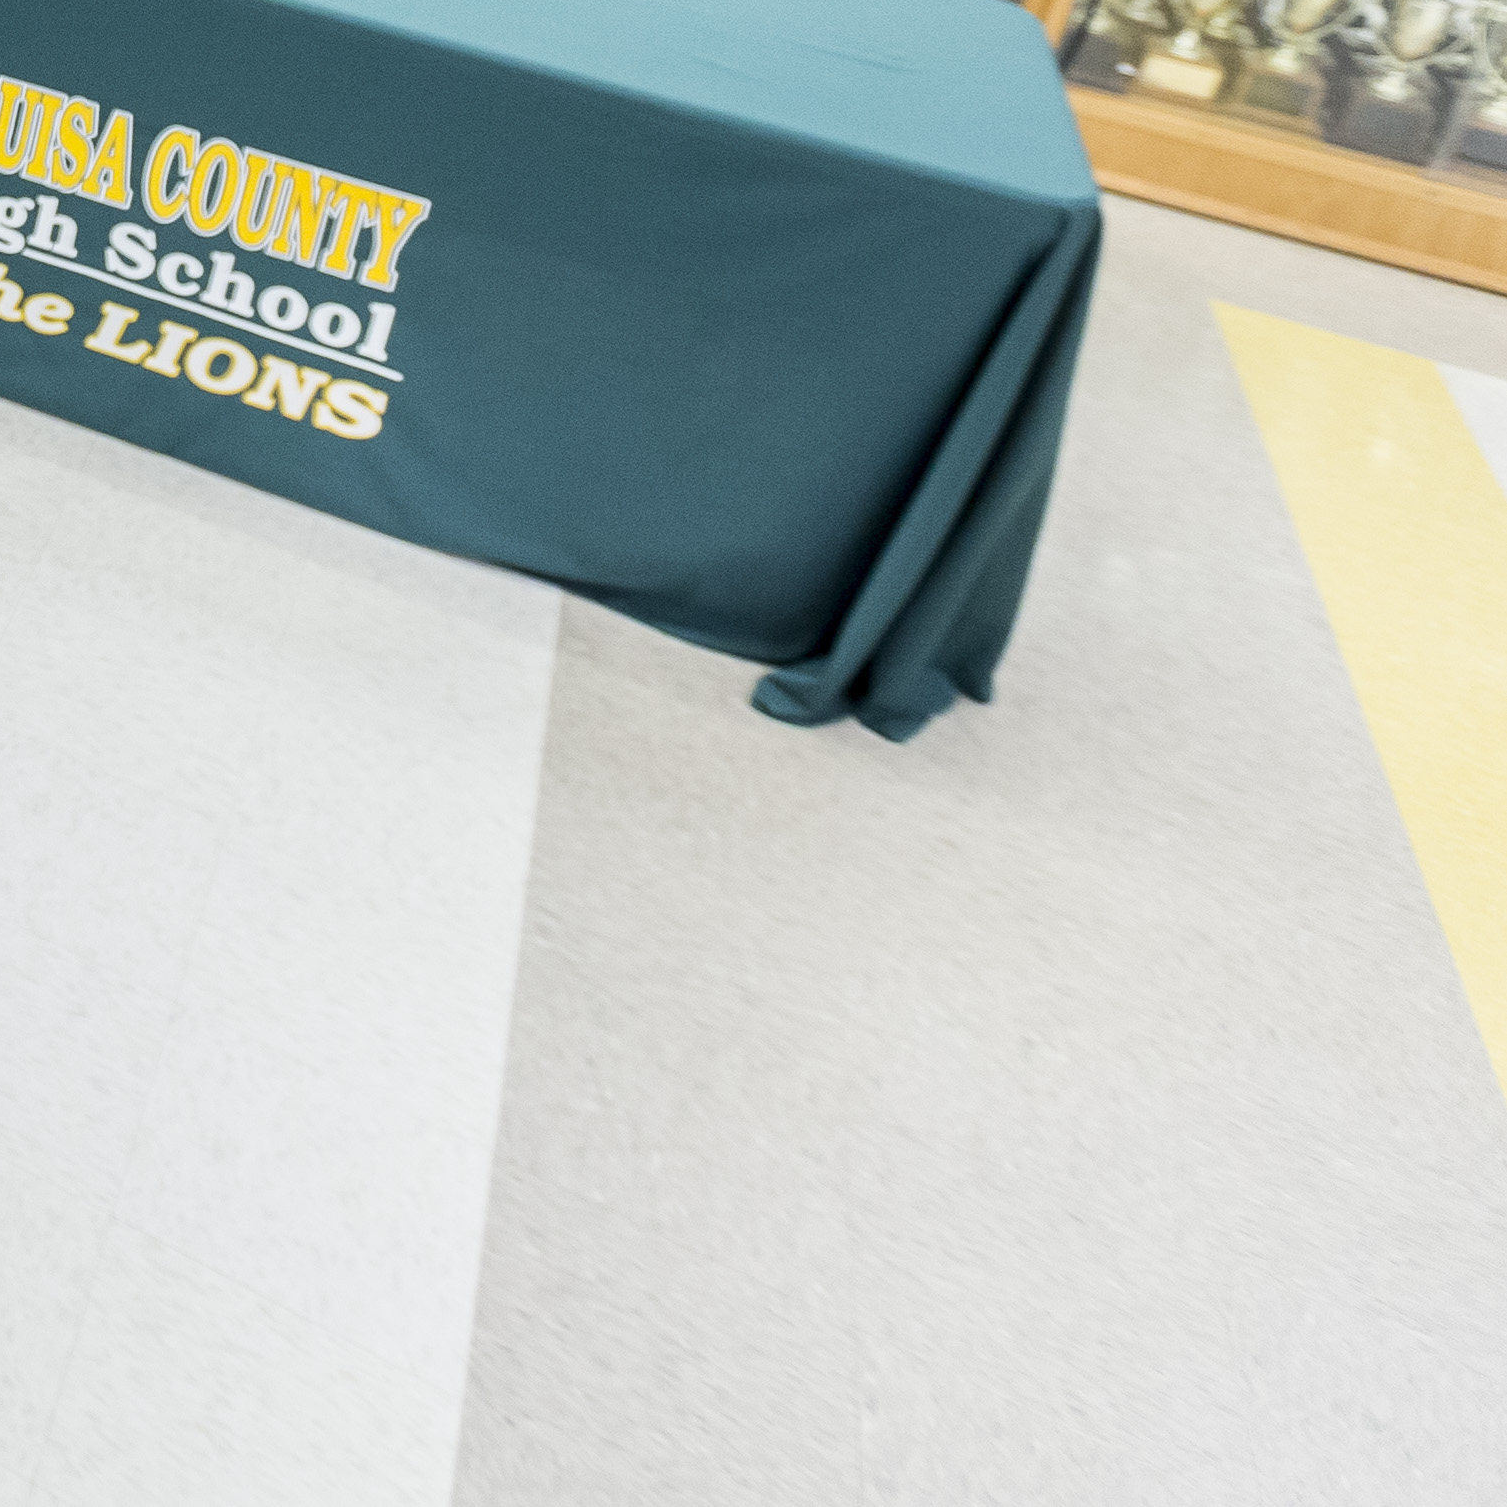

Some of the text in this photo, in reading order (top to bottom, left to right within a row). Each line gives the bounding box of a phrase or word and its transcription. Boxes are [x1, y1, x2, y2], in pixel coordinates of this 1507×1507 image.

[142, 124, 432, 293] COUNTY
[104, 221, 398, 364] School
[84, 300, 389, 441] LIONS
